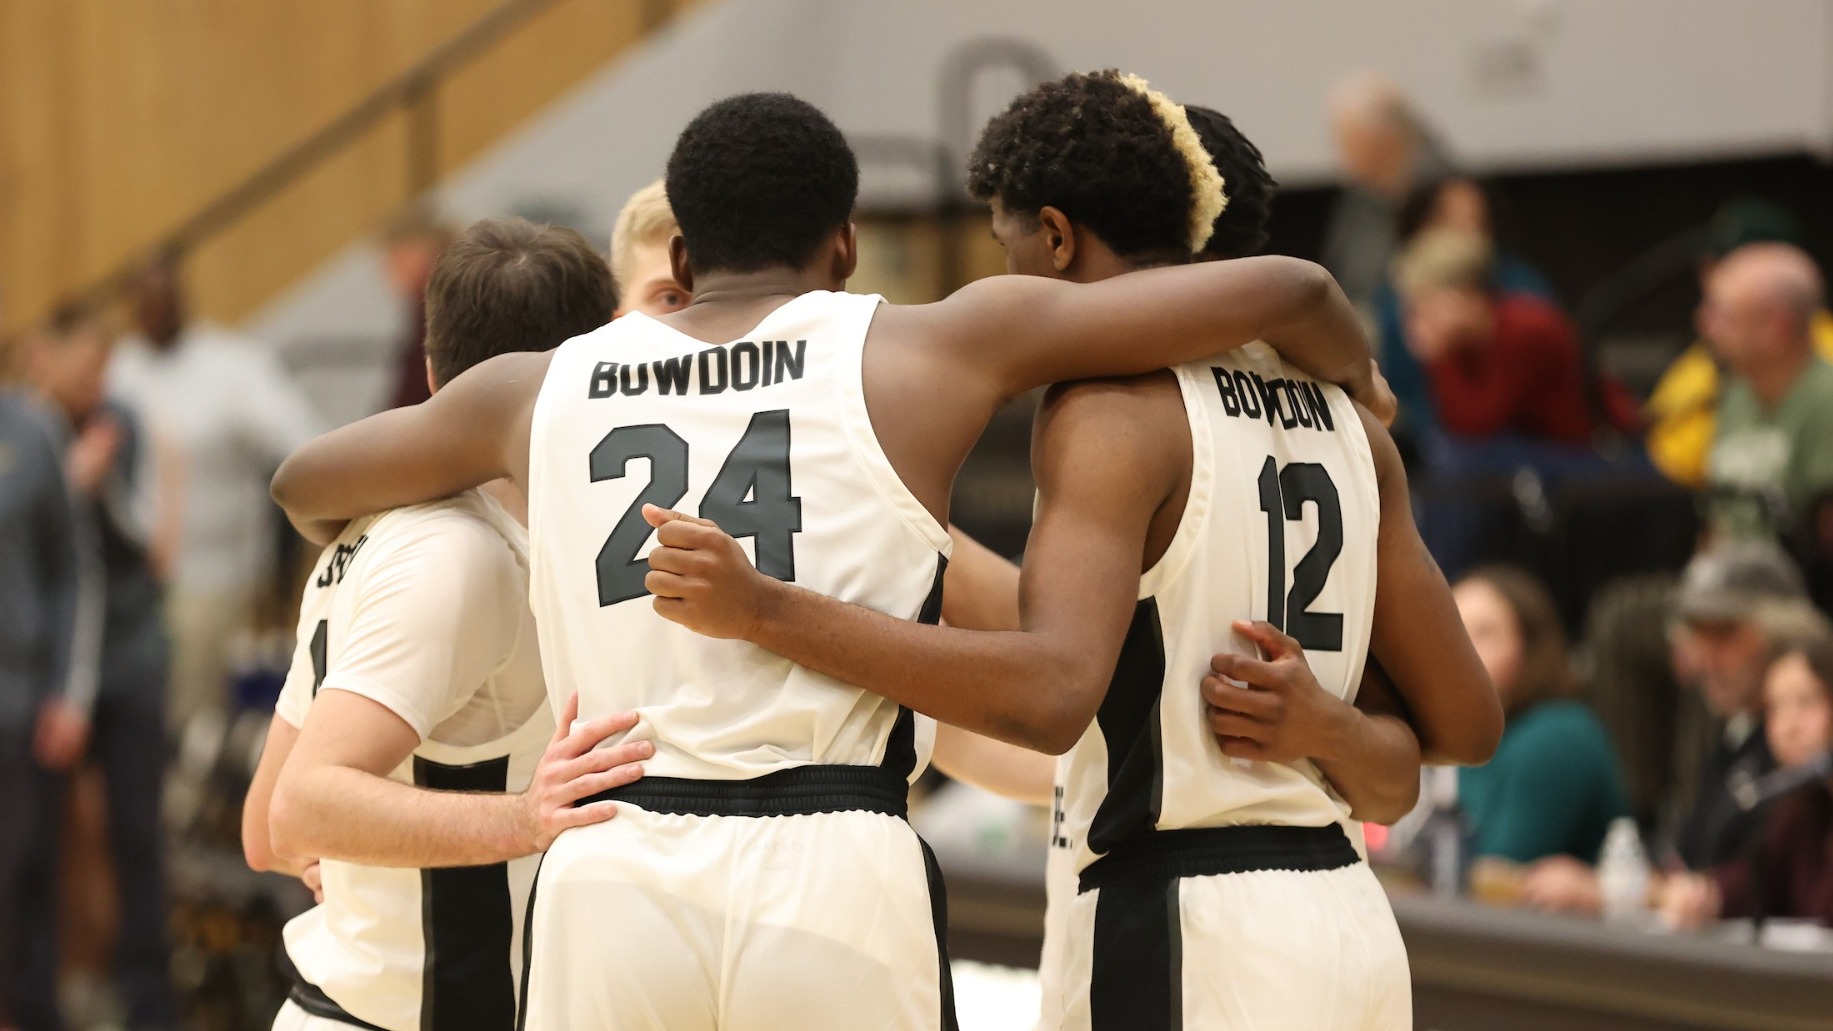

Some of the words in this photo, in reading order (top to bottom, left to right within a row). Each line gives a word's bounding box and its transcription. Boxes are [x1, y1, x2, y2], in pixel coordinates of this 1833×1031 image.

[588, 339, 807, 399] BOWDOIN
[1210, 366, 1335, 431] BOWDON
[589, 408, 801, 607] 24
[1258, 455, 1344, 652] 12
